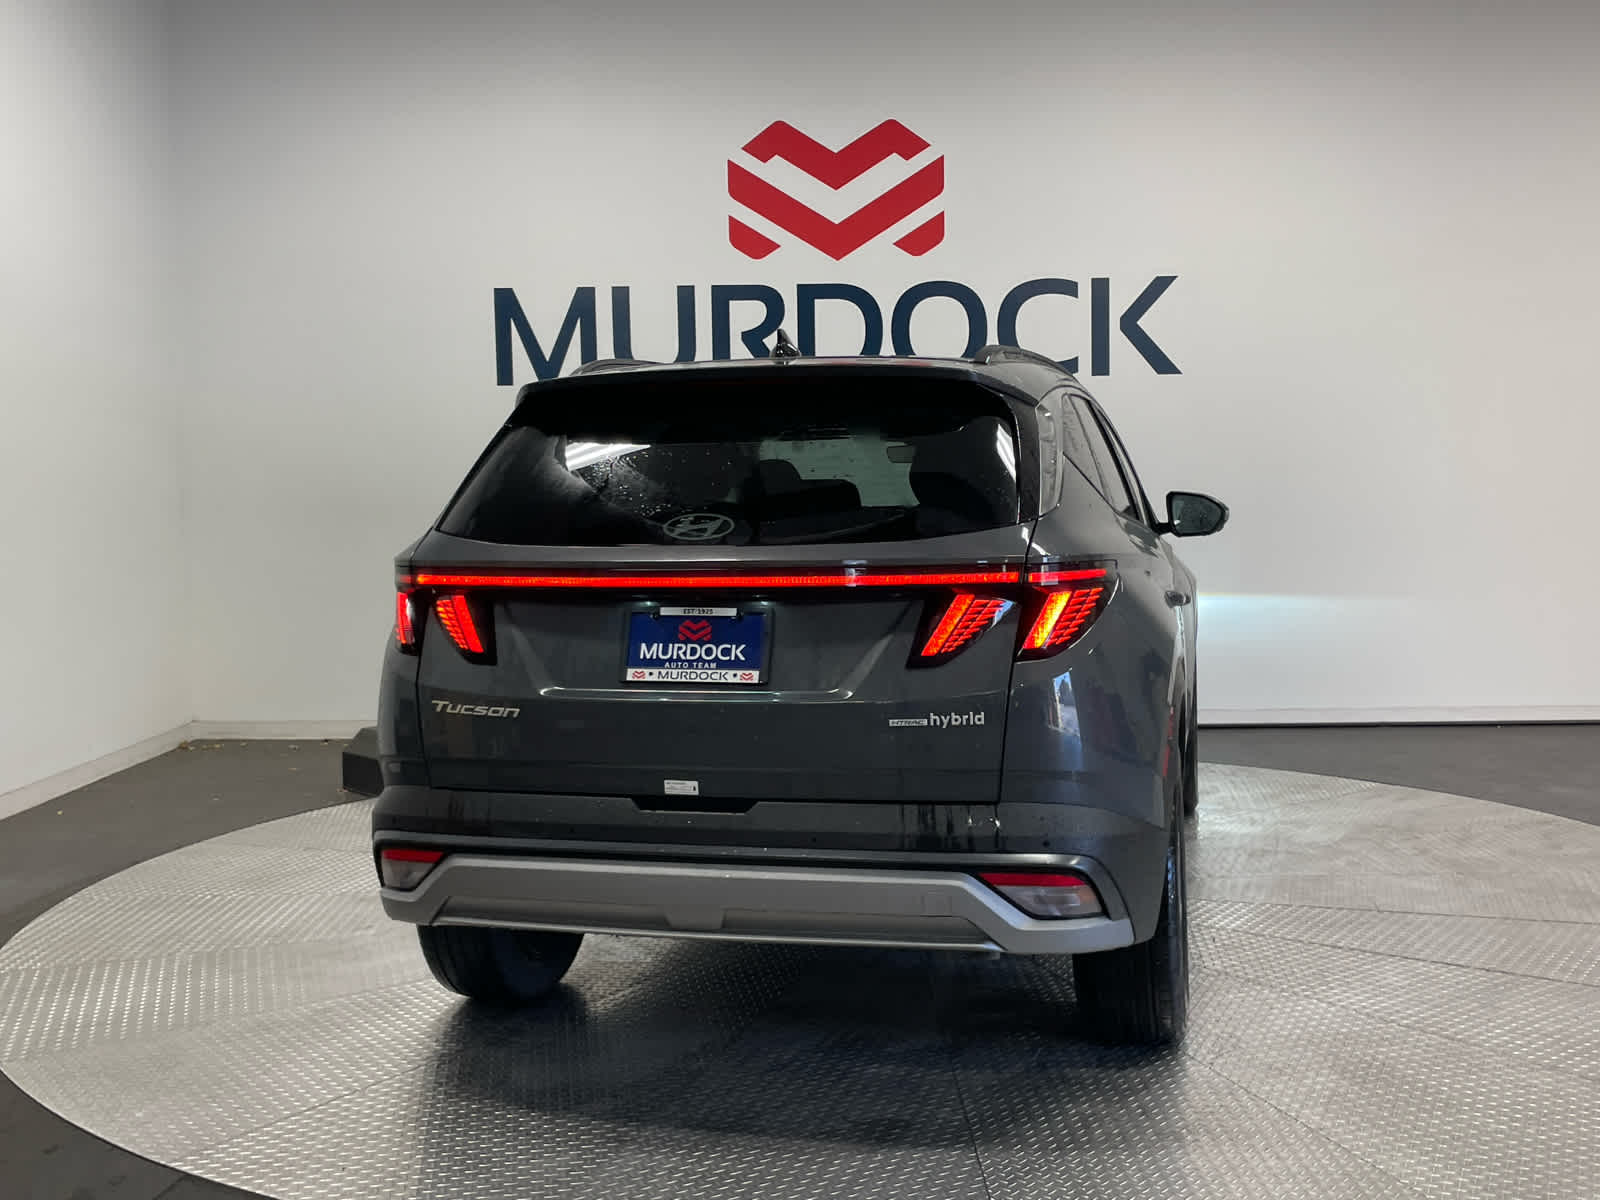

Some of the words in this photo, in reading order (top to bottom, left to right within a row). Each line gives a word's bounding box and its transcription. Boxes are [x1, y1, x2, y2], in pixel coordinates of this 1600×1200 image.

[494, 275, 1182, 386] MURDOCK
[639, 643, 746, 661] MURDOCK
[664, 661, 689, 669] AUTO
[657, 671, 728, 681] MURDOCK
[929, 711, 985, 729] hybrid
